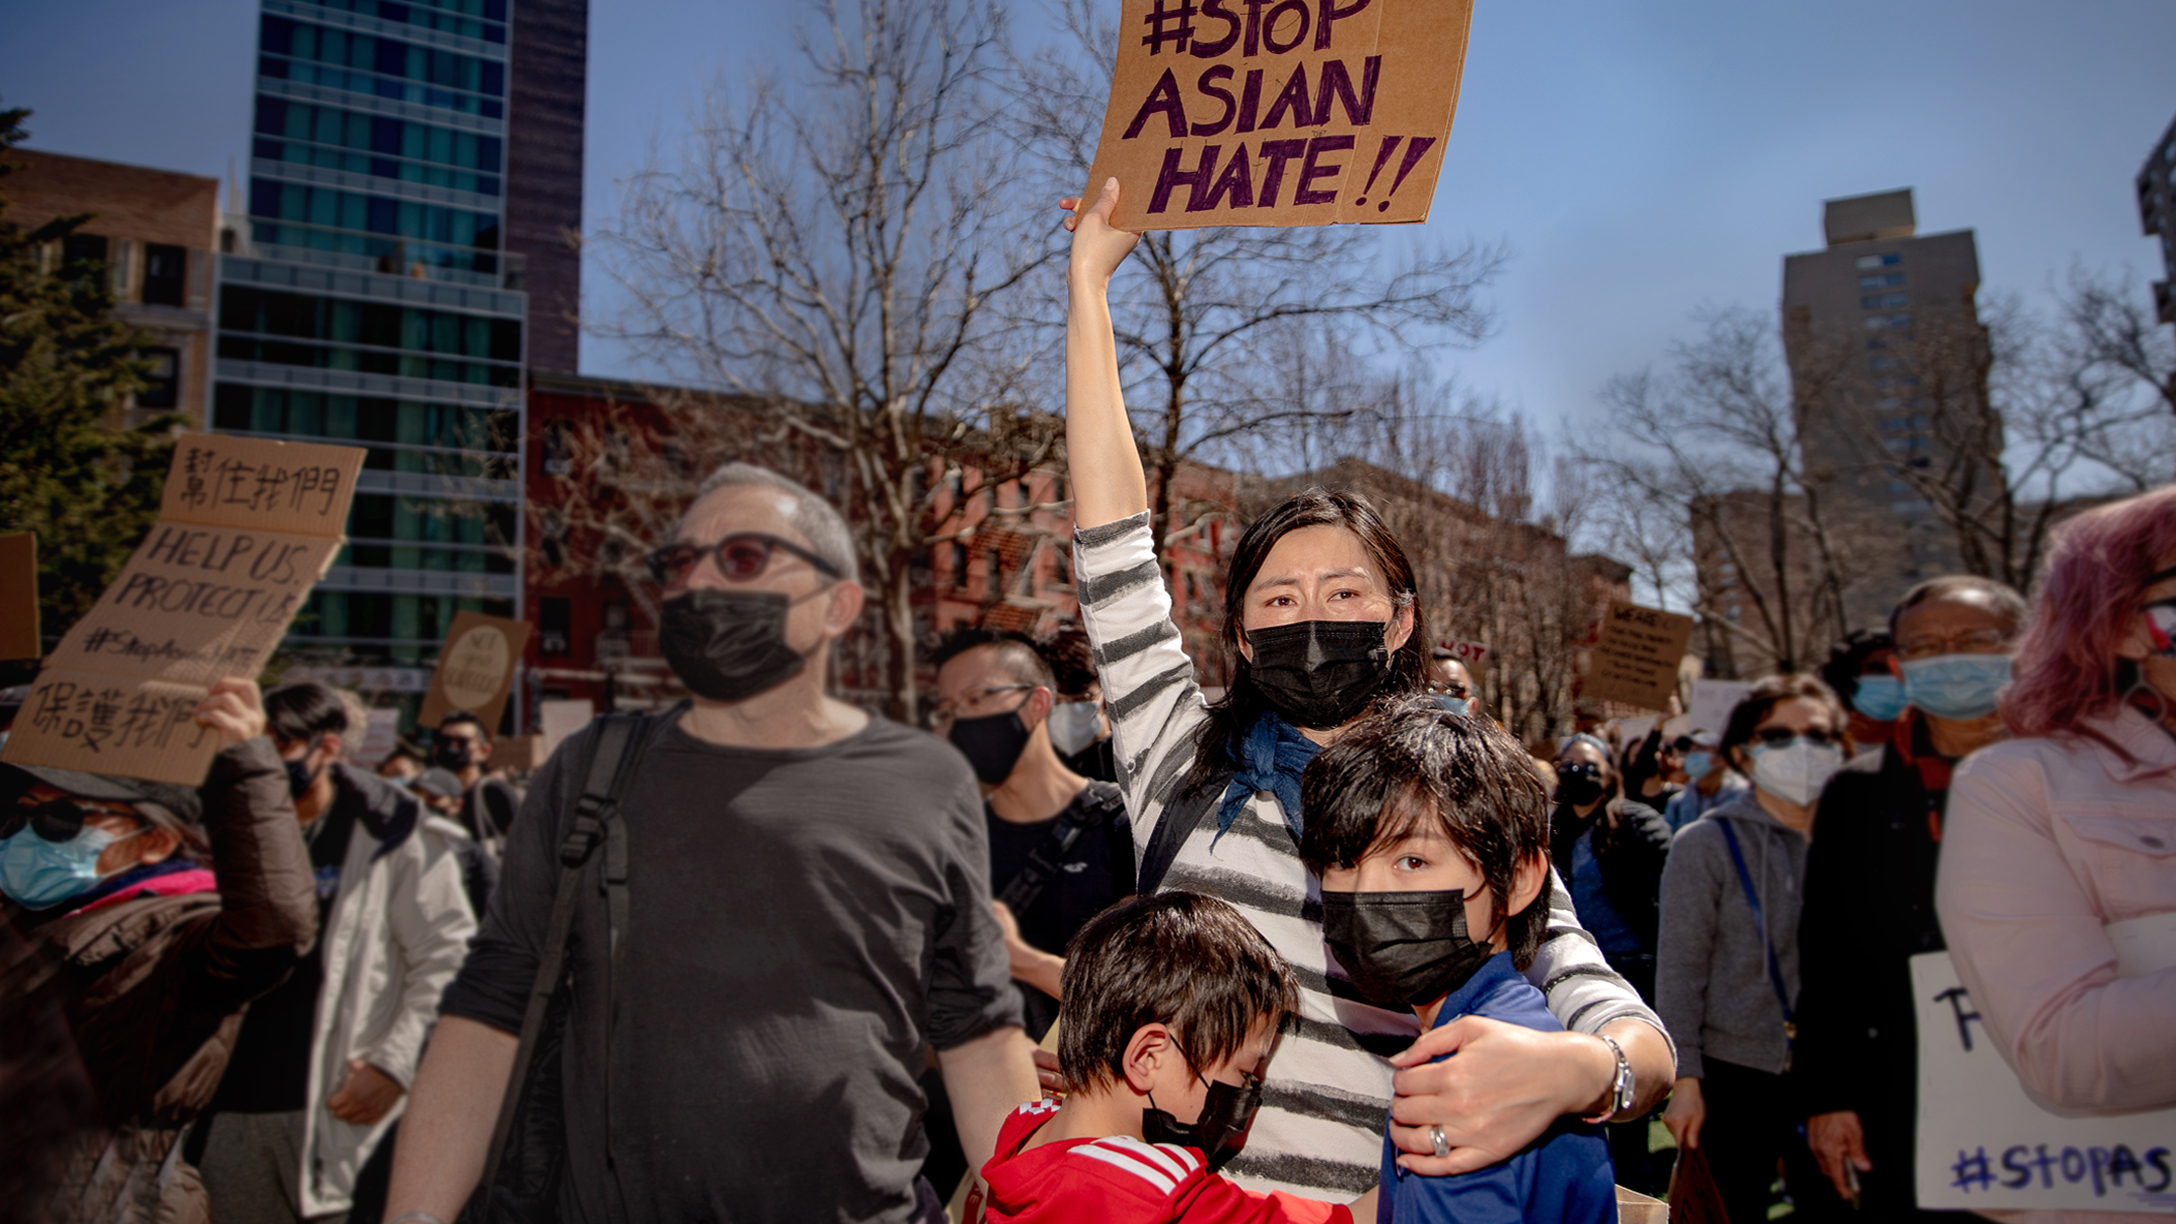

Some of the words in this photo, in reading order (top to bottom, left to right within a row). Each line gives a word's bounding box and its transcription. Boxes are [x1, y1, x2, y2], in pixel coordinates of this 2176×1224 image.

[1141, 0, 1372, 58] #STOP
[1121, 54, 1382, 140] ASIAN
[147, 526, 254, 572] HELP
[114, 572, 263, 620] PROTECT
